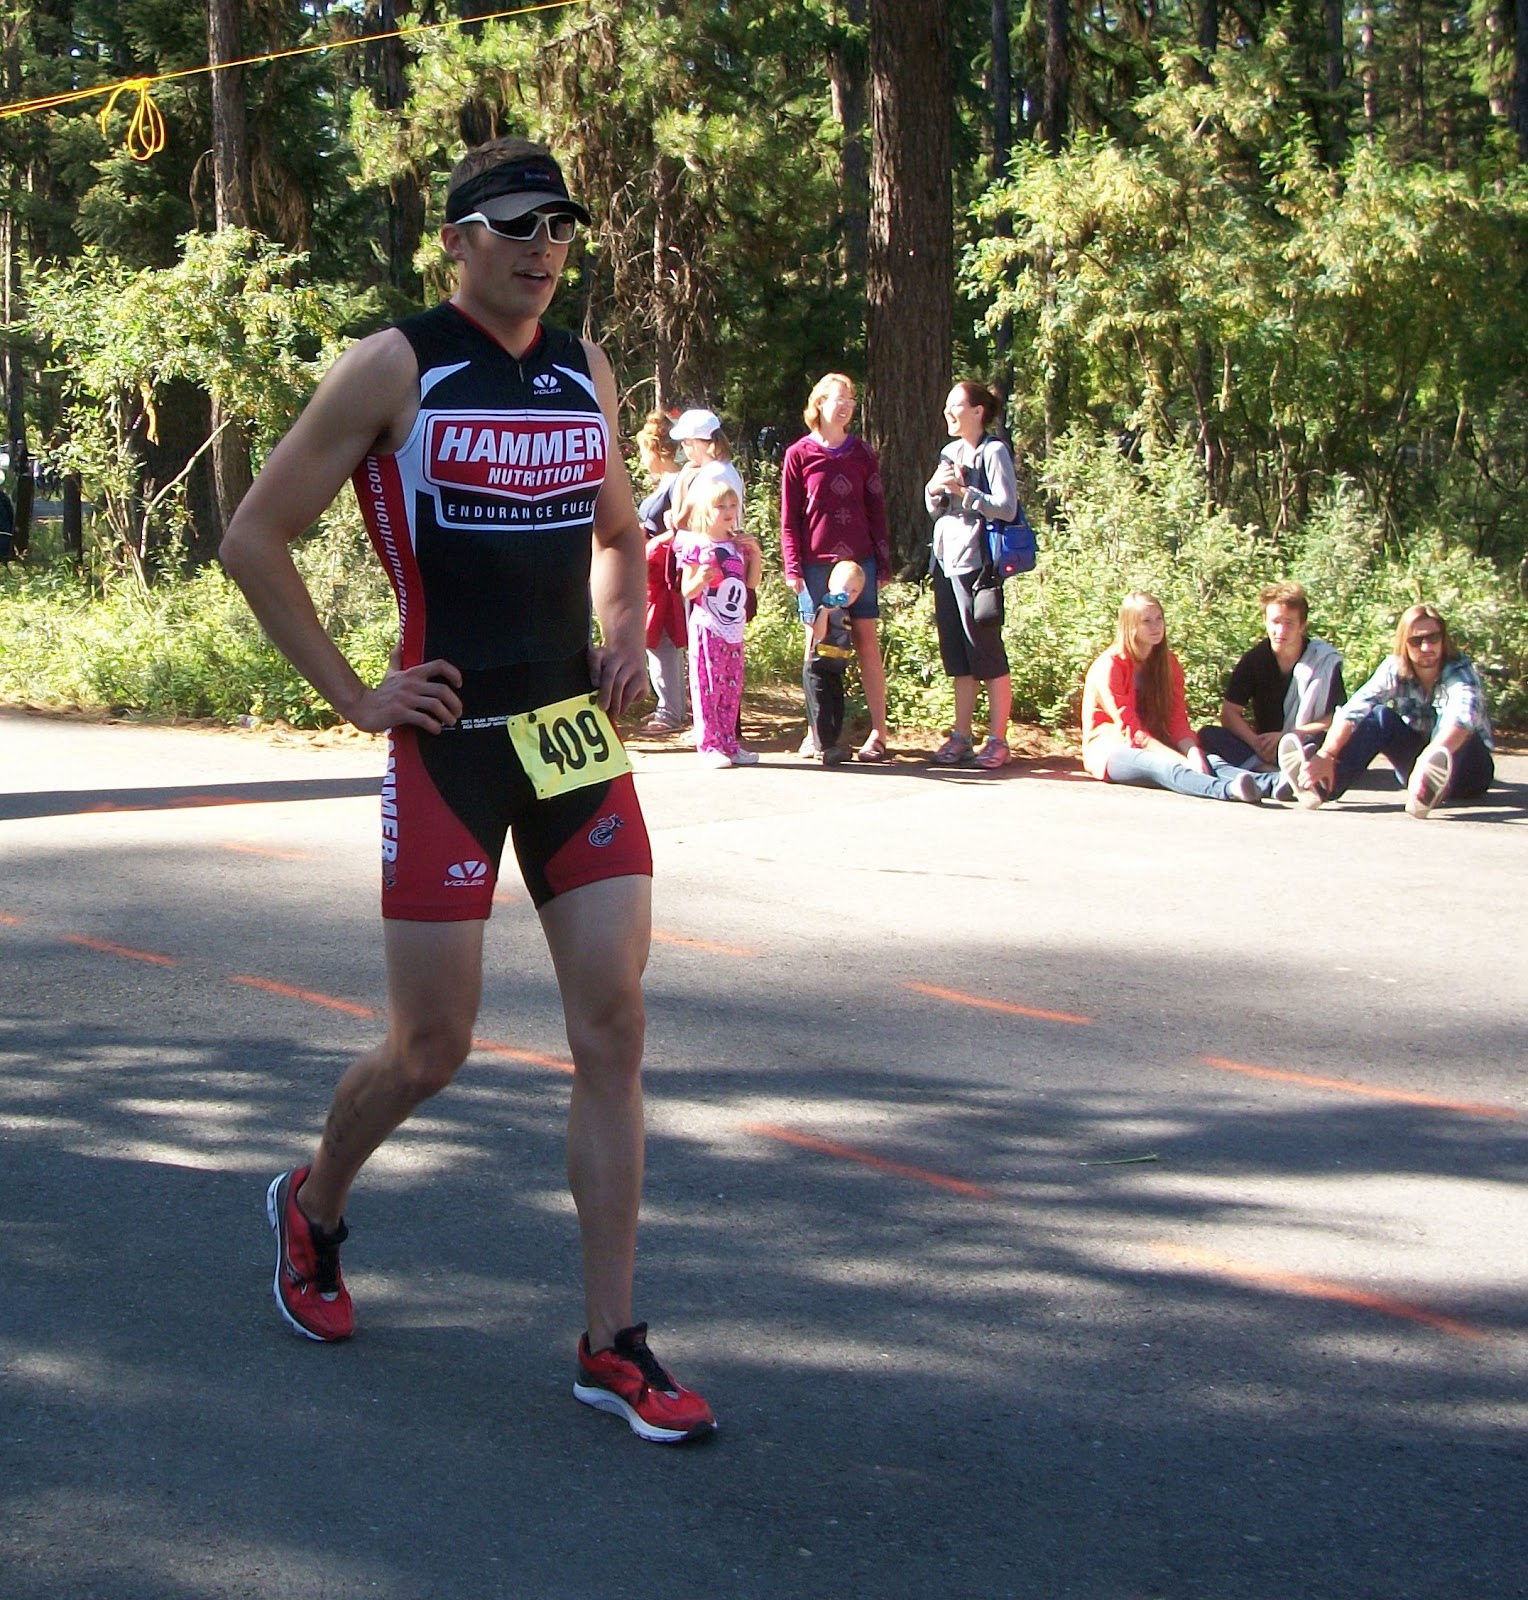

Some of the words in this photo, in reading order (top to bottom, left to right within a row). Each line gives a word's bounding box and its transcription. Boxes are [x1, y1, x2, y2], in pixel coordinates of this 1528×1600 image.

[437, 426, 603, 467] HAMMER
[447, 504, 554, 519] ENDURANCE
[537, 710, 609, 775] 409
